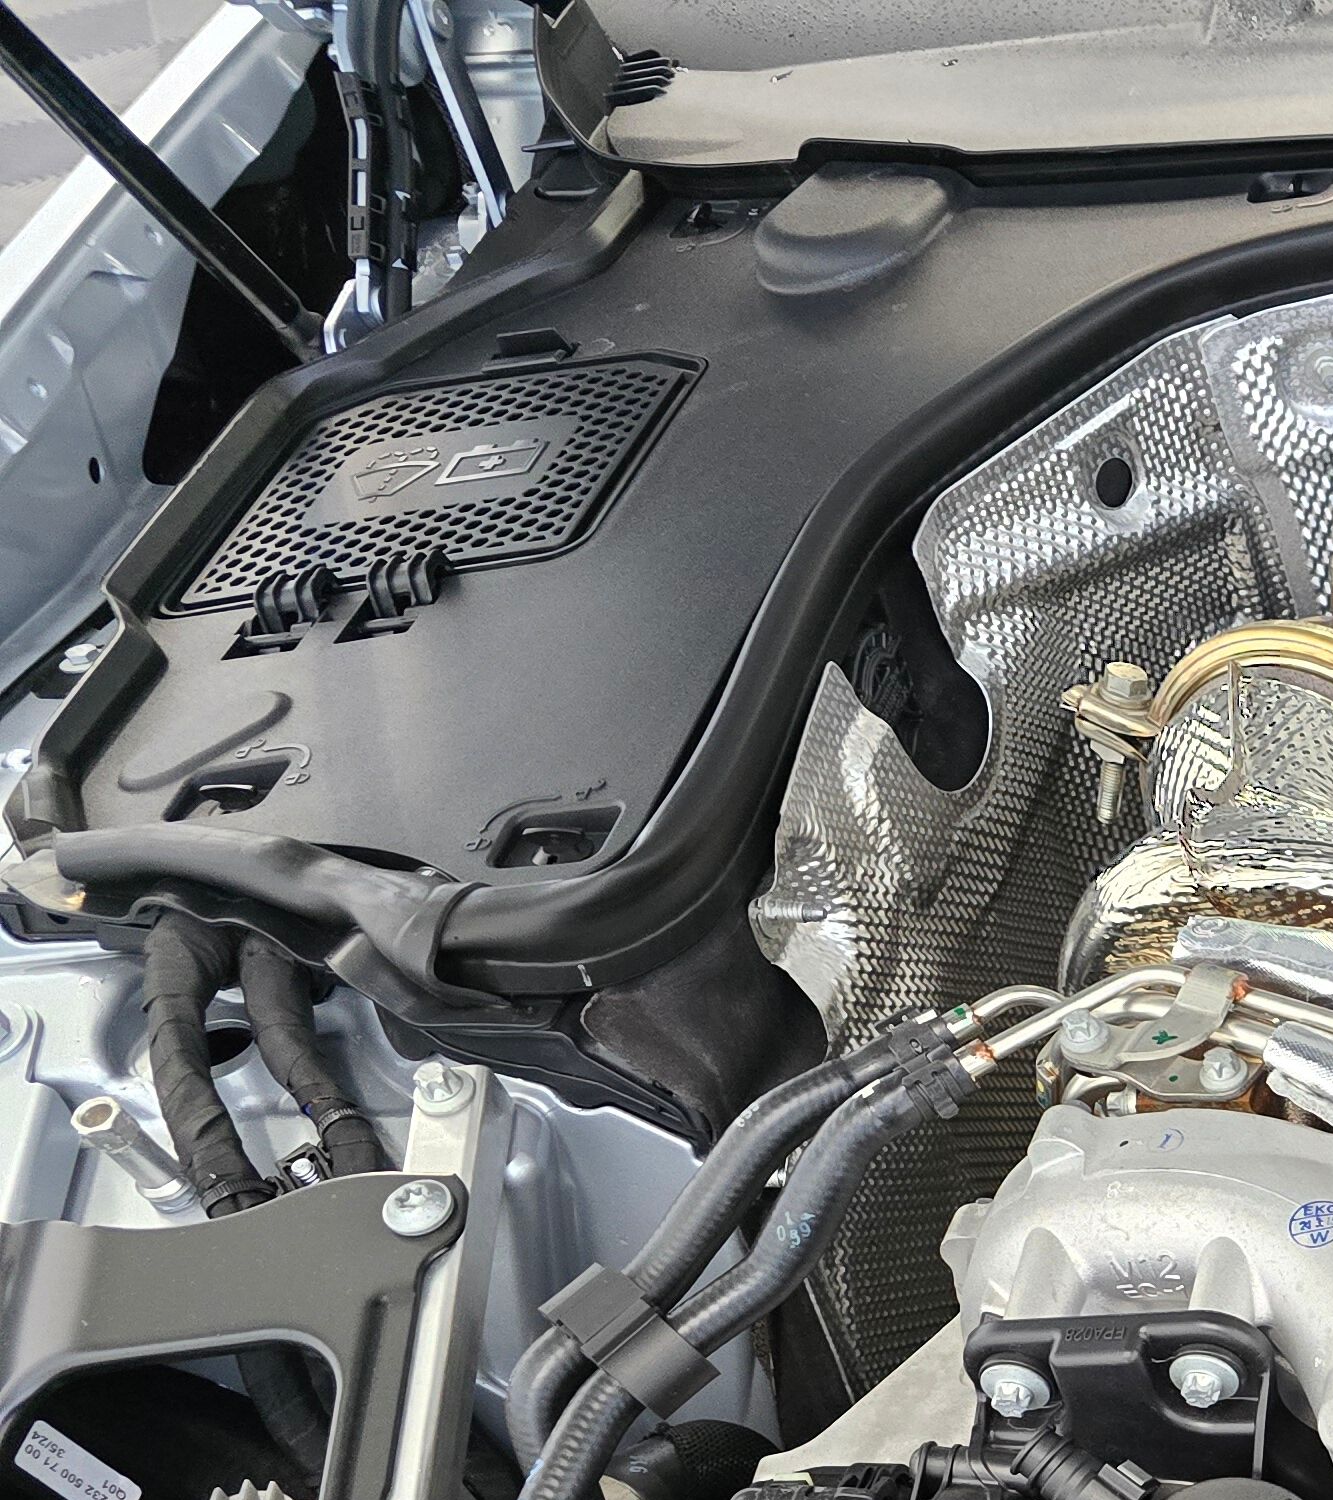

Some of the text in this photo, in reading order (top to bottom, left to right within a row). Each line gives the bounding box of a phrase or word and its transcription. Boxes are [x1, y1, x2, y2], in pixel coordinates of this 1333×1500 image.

[1310, 1230, 1329, 1244] W
[24, 1444, 41, 1459] 00
[31, 1431, 126, 1500] Q01 35/24
[43, 1457, 59, 1473] 71
[61, 1469, 84, 1488] 500
